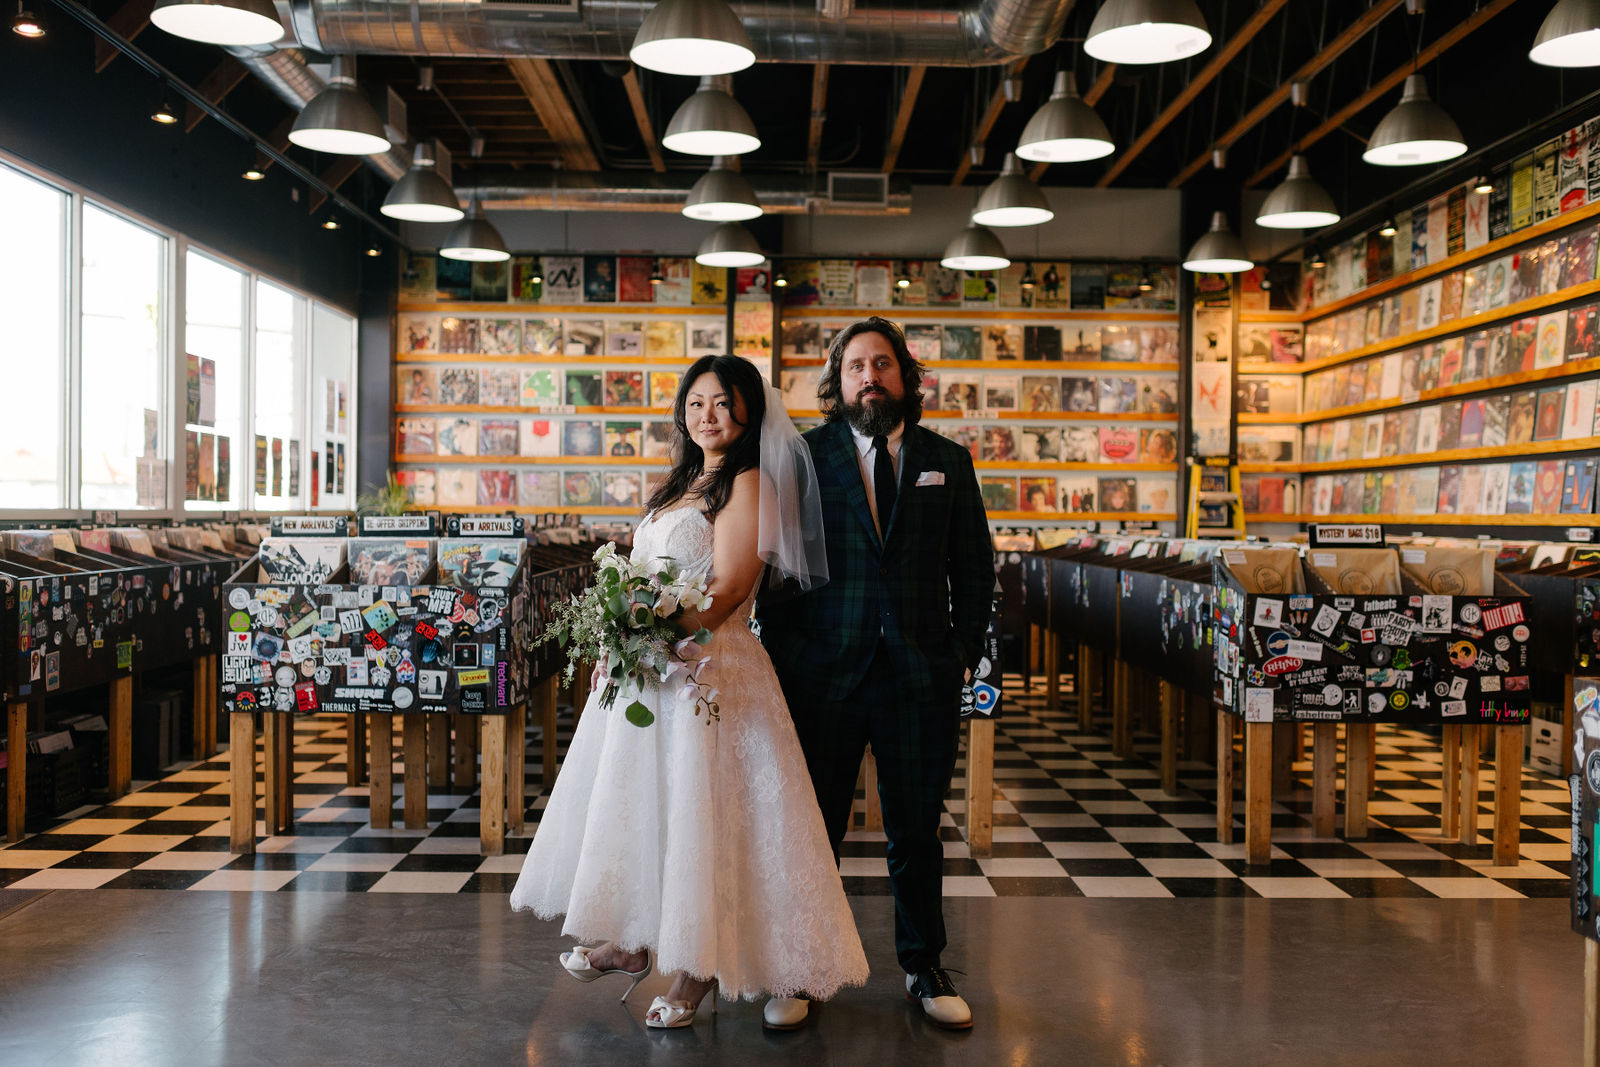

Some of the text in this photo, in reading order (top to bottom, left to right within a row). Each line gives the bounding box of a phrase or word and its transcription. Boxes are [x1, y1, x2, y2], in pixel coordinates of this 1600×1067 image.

[284, 521, 335, 530] NEW ARRIVALS
[377, 519, 395, 528] OFFER
[398, 519, 428, 528] SHIPPING
[461, 522, 512, 532] NEW ARRIVALS
[1319, 528, 1345, 538] MYSTERY
[1348, 528, 1363, 538] BAGS
[284, 572, 329, 585] LONDON
[427, 600, 453, 615] MFB
[1364, 598, 1397, 612] fatbeats
[230, 643, 248, 651] JW
[225, 656, 250, 668] LIGHT
[1267, 657, 1301, 673] RHINO
[236, 668, 251, 682] UP
[497, 661, 508, 706] fredward
[334, 687, 385, 699] SHURE
[321, 702, 356, 712] THERMALS
[1480, 700, 1529, 722] titty bingo
